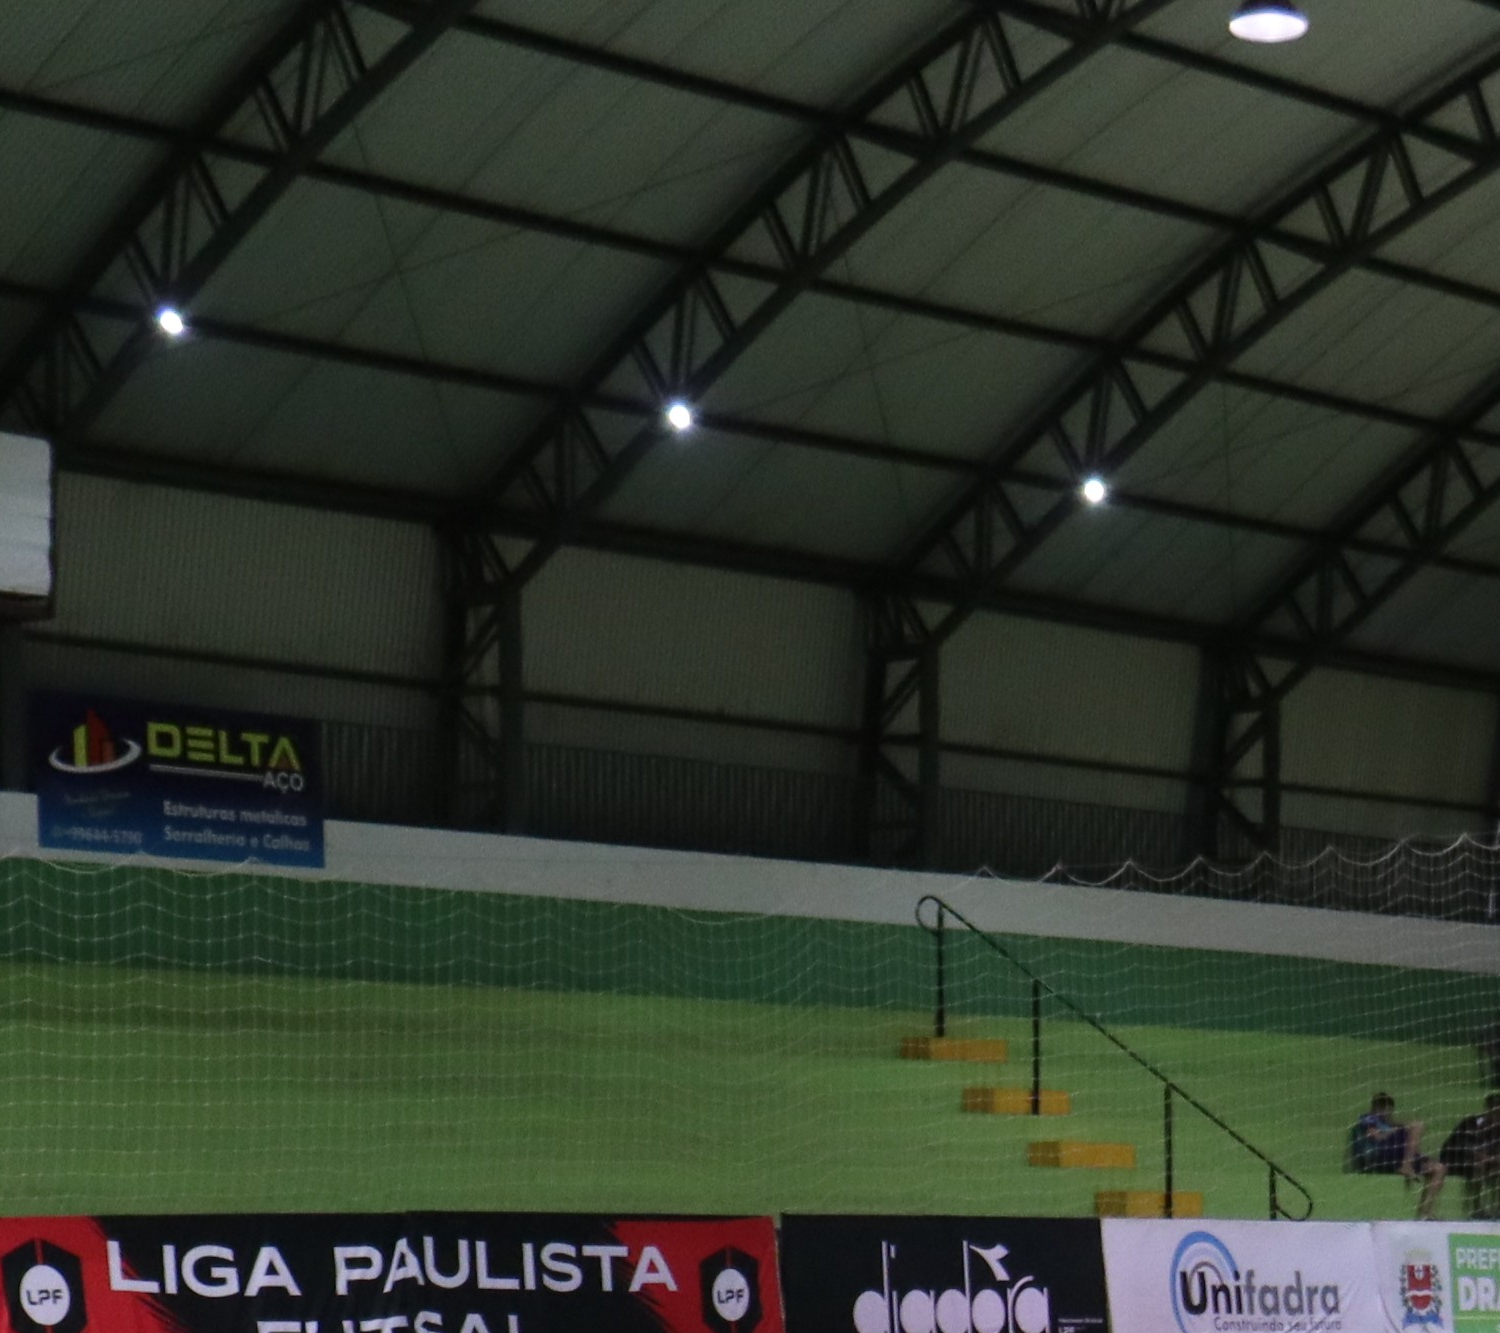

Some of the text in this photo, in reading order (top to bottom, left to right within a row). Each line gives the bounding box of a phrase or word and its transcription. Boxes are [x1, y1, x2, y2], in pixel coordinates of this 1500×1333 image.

[147, 721, 301, 770] DELTA
[264, 771, 304, 794] AÇO
[163, 799, 237, 821] Estruturas
[263, 834, 310, 852] Calhas
[107, 1236, 678, 1297] LIGA PAULISTA
[26, 1288, 63, 1306] LPF
[717, 1288, 744, 1304] LPF
[1180, 1269, 1340, 1315] Unifadra
[1213, 1316, 1284, 1332] Construindo
